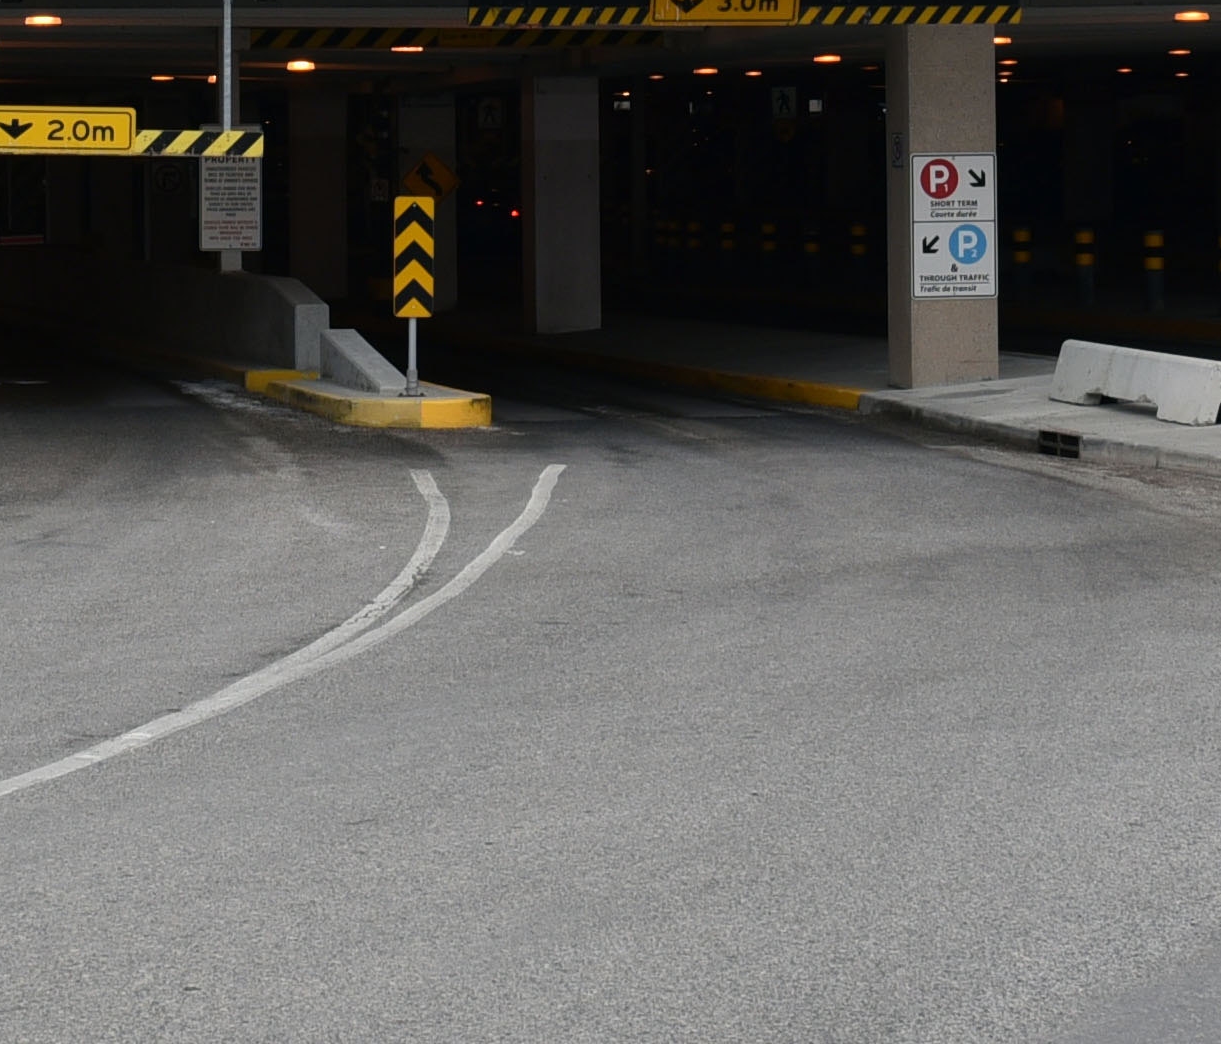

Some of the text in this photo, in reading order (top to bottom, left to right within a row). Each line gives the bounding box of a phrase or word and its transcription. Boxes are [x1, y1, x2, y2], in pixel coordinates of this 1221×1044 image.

[47, 119, 115, 142] 2.0m
[958, 199, 978, 207] TERM
[920, 273, 989, 282] THROUGH TRAFFIC
